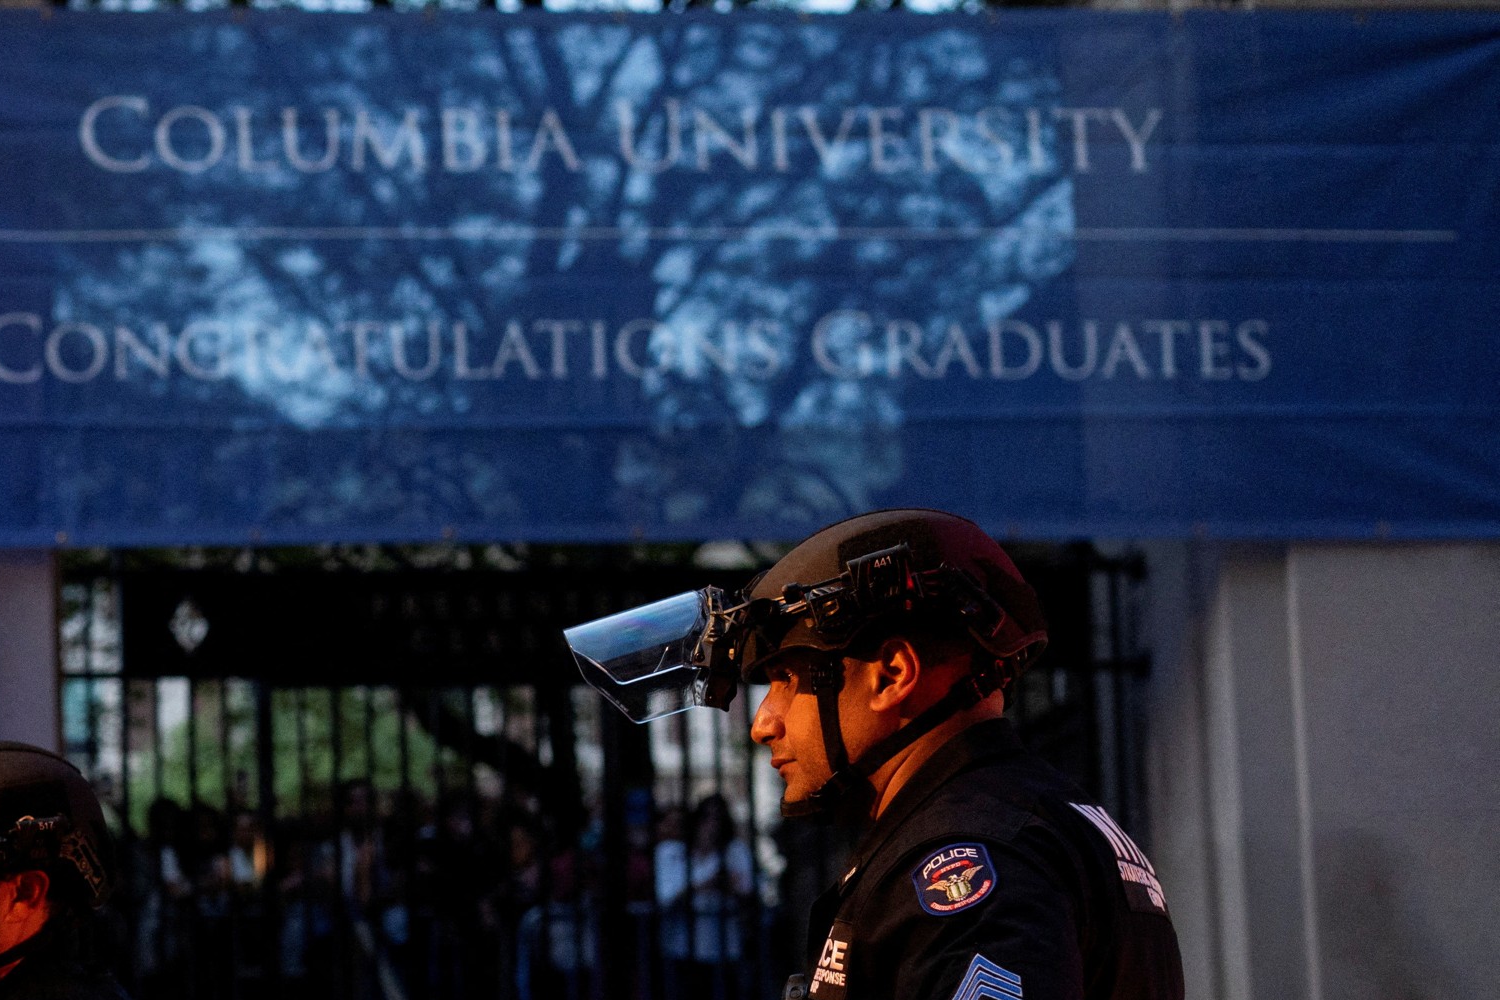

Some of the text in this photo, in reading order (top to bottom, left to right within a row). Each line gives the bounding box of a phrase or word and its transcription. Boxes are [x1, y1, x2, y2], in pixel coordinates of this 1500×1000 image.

[79, 96, 1162, 175] COLUMBIA UNIVERSITY
[811, 309, 1273, 385] GRADUATES
[873, 555, 892, 568] 441
[922, 847, 979, 880] POLICE
